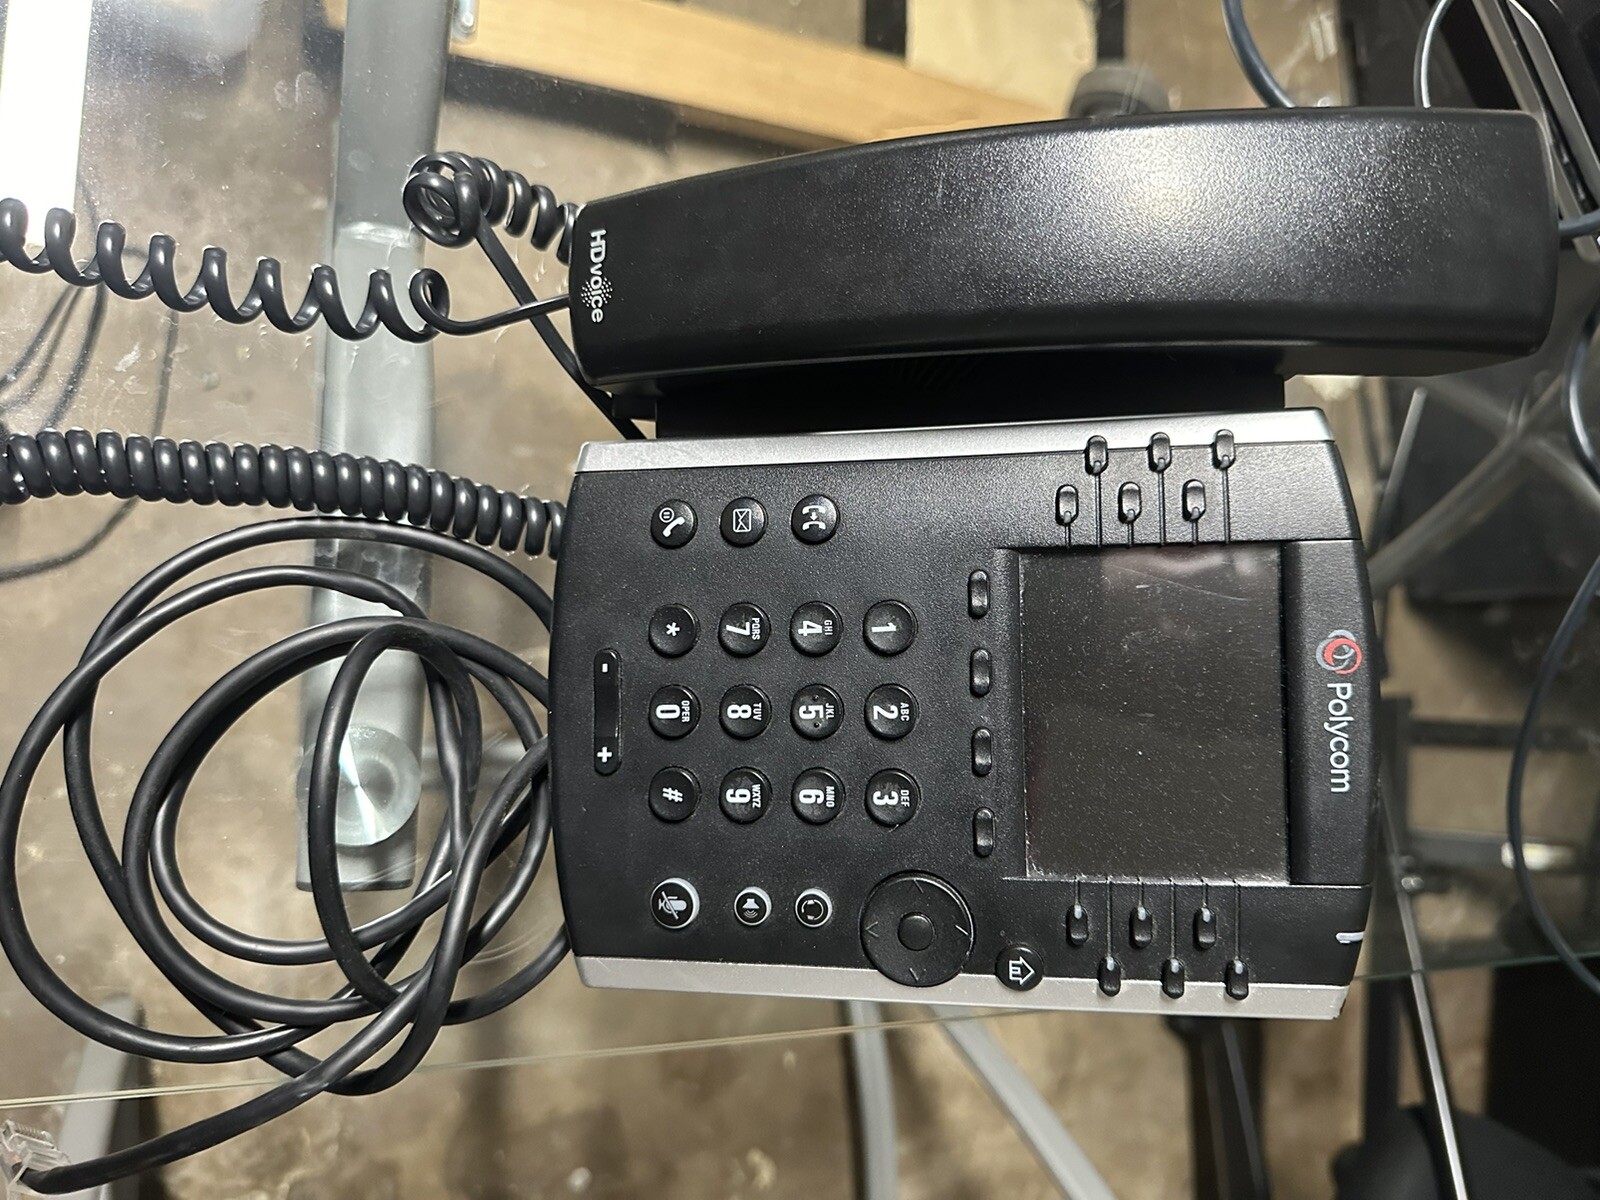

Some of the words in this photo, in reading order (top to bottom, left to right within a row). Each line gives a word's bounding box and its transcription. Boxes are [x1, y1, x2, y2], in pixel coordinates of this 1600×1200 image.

[725, 621, 751, 636] 7
[751, 617, 761, 641] PQRS
[798, 620, 822, 637] 4
[824, 619, 833, 636] GHI
[871, 622, 897, 633] 1
[681, 700, 691, 723] OPER
[726, 704, 752, 719] 8
[752, 702, 762, 721] TUV
[799, 704, 824, 720] 5
[825, 702, 835, 720] JKL
[873, 705, 899, 720] 2
[900, 702, 910, 722] ABC
[1323, 682, 1355, 793] Polycom
[662, 786, 684, 803] #
[725, 788, 752, 804] 9
[752, 783, 762, 809] WXYZ
[799, 788, 825, 805] 6
[825, 785, 836, 808] MNO
[872, 790, 899, 806] 3
[900, 789, 911, 808] DEF
